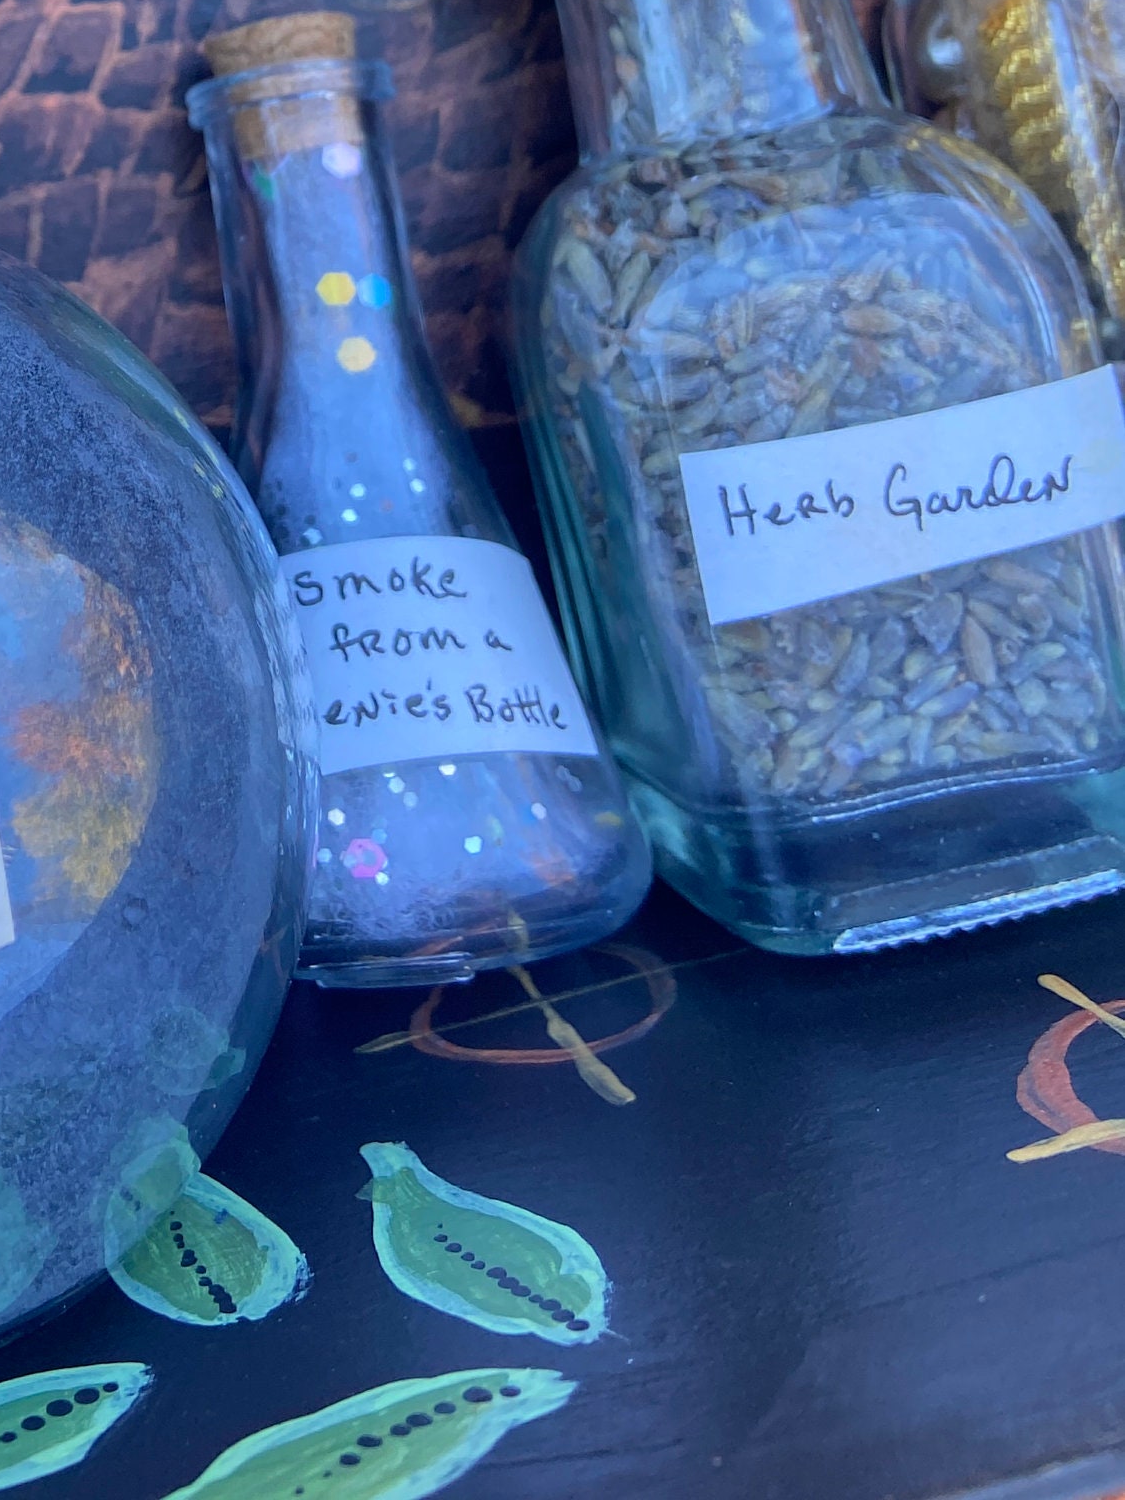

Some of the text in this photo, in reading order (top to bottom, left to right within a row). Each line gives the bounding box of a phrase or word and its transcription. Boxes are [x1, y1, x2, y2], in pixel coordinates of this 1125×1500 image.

[883, 452, 1072, 532] Garden
[330, 622, 513, 662] from a
[322, 679, 568, 731] enie's Bottle
